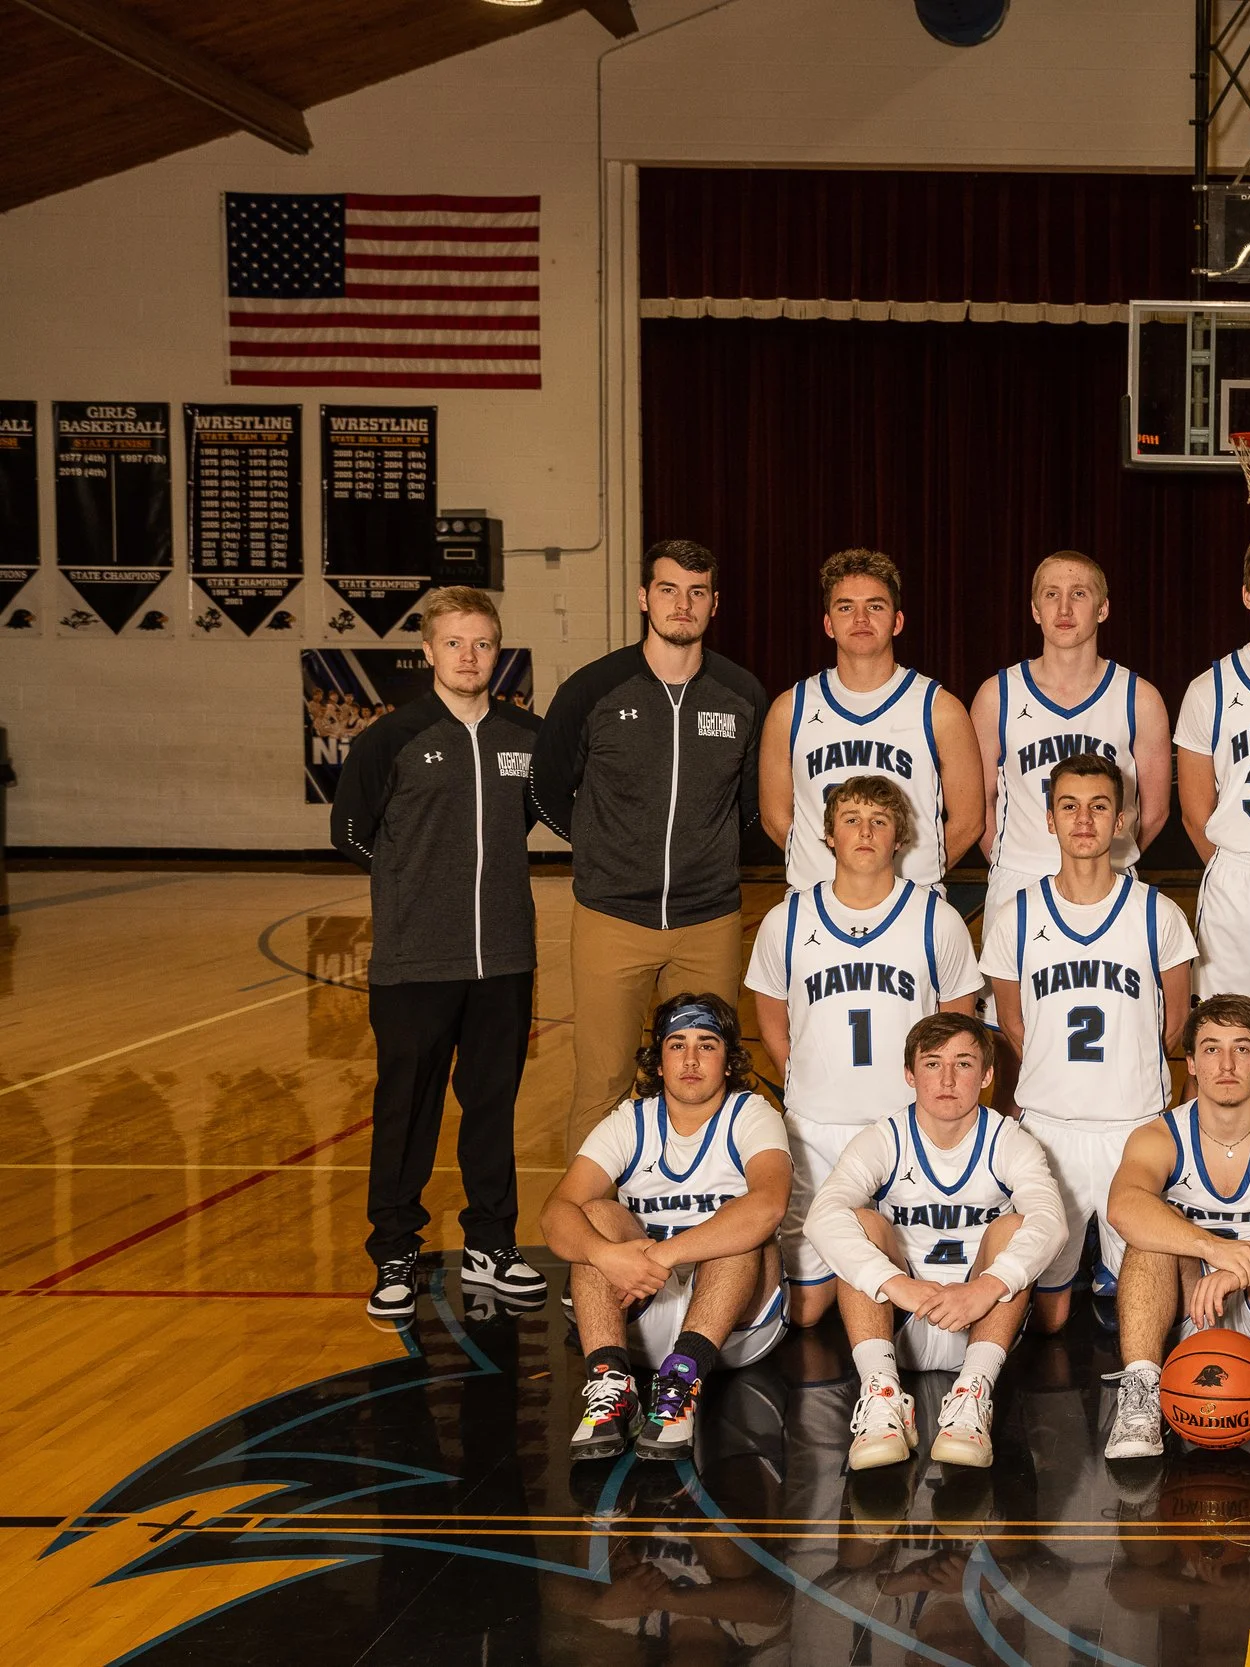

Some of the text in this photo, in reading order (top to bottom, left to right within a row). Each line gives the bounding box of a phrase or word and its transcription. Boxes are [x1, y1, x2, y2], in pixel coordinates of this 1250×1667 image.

[86, 406, 137, 419] GIRLS
[0, 419, 33, 432] ALL
[58, 420, 166, 434] BASKETBALL
[196, 416, 293, 430] WRESTLING
[330, 417, 428, 431] WRESTLING
[72, 438, 152, 449] STATE FINISH
[199, 433, 228, 442] STATE
[69, 570, 161, 581] STATE CHAMPIONS
[206, 578, 289, 587] STATE CHAMPIONS
[338, 580, 421, 589] STATE CHAMPIONS
[395, 659, 414, 669] ALL
[697, 711, 736, 732] NIGHTHAWK
[698, 728, 736, 739] BASKETBALL
[806, 740, 912, 780] HAWKS
[804, 962, 915, 1006] HAWKS
[1031, 960, 1140, 1001] HAWKS
[848, 1009, 872, 1067] 1
[1067, 1005, 1105, 1062] 2
[923, 1239, 968, 1264] 4
[1172, 1404, 1249, 1429] SPALDING
